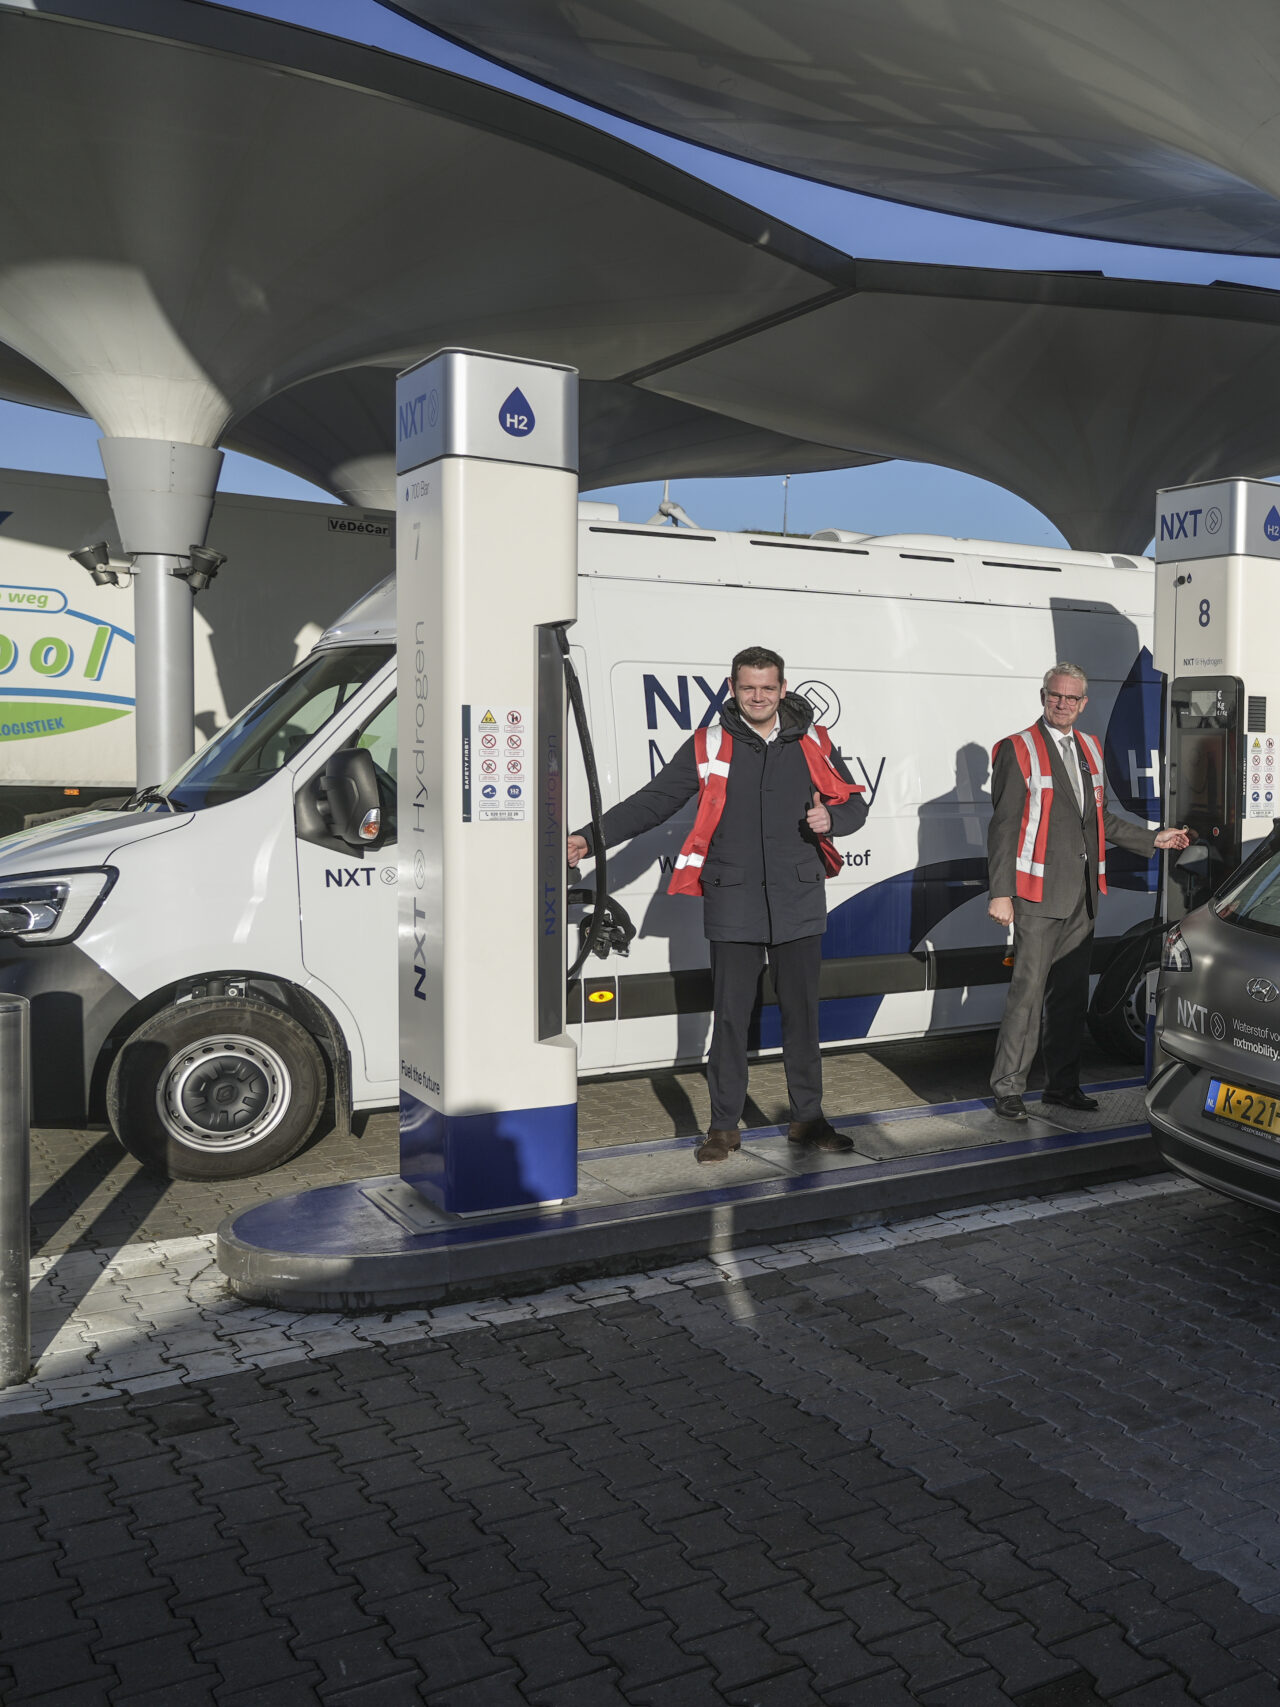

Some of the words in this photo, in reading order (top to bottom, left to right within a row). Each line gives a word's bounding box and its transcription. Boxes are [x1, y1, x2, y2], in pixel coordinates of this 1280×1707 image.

[399, 393, 426, 442] NXT
[506, 413, 528, 430] H2
[421, 480, 430, 497] Bar
[330, 519, 388, 535] VéDéCar
[1160, 508, 1203, 541] NXT
[1267, 524, 1280, 536] H2
[412, 521, 421, 561] 7
[8, 592, 49, 609] weg
[1199, 598, 1210, 627] 8
[1183, 658, 1194, 666] NXT
[0, 716, 65, 736] OGISTIEK
[412, 621, 429, 833] Hydrogen
[1128, 749, 1161, 798] H
[325, 867, 376, 888] NXT
[545, 881, 556, 936] NXT
[413, 896, 427, 1001] NXT
[1177, 996, 1208, 1034] NXT
[1232, 1018, 1269, 1038] Waterstof
[401, 1060, 413, 1080] Fuel
[413, 1066, 422, 1085] the
[422, 1071, 440, 1095] future
[1207, 1099, 1215, 1108] NL
